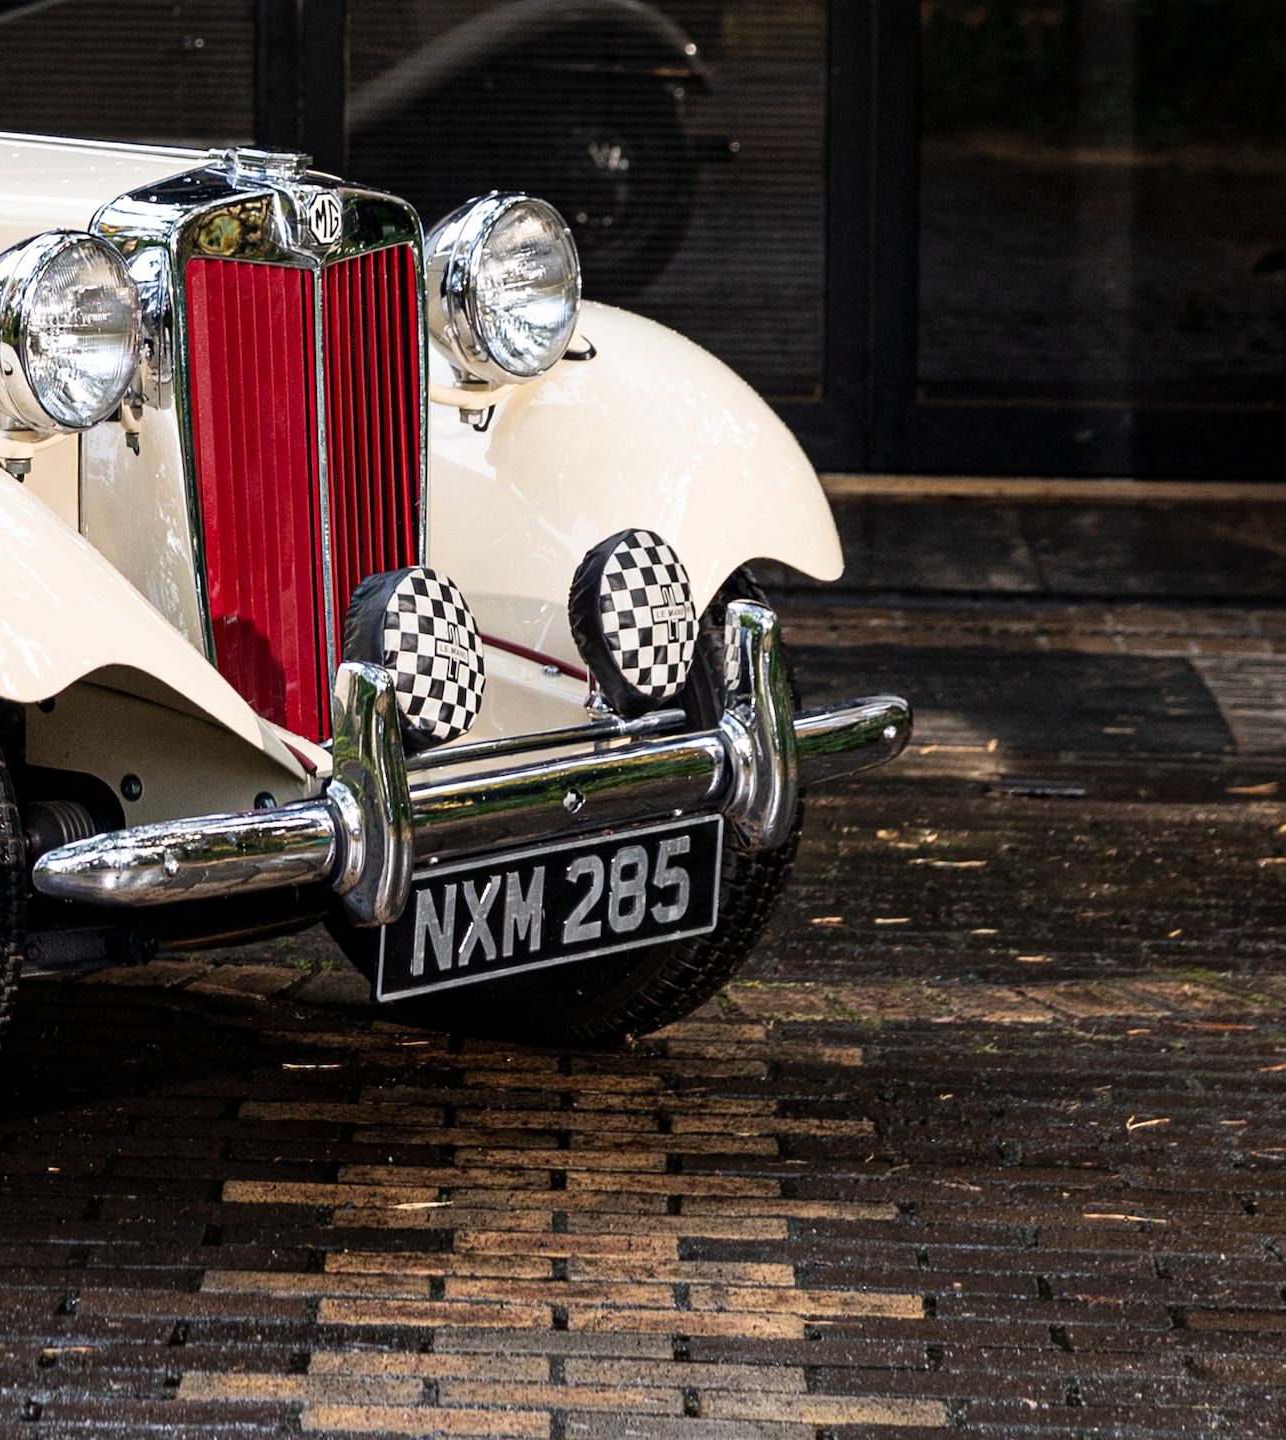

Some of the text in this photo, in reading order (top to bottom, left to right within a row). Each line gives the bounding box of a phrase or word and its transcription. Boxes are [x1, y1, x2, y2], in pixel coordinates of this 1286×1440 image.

[312, 194, 342, 242] MG
[409, 834, 692, 977] NXM 285
